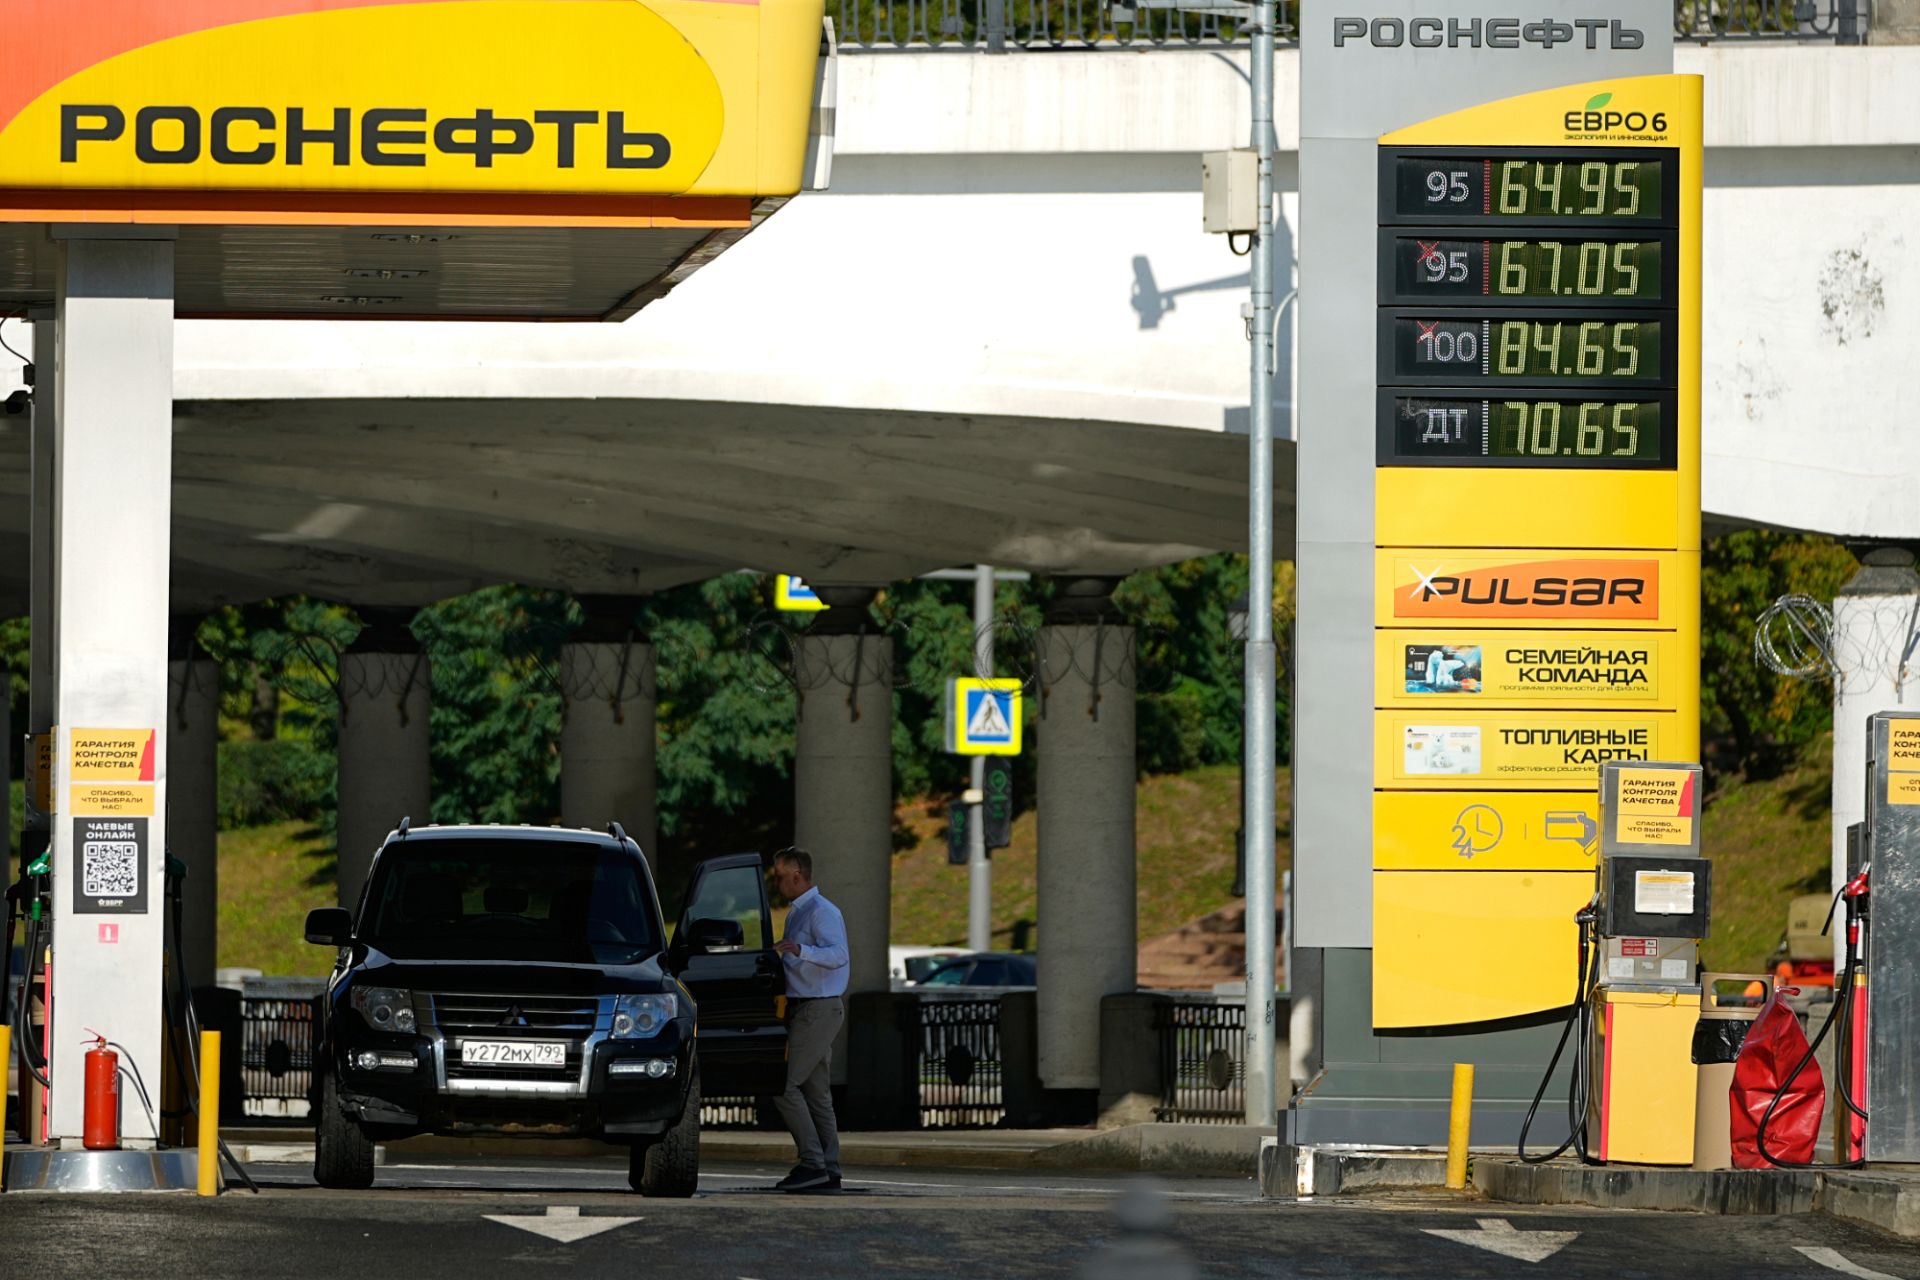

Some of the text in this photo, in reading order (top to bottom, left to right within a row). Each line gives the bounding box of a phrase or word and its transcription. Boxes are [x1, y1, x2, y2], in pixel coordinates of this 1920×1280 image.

[1333, 16, 1645, 50] РОСНЕФТЬ
[60, 104, 672, 169] РОСНЕФТЬ
[1426, 160, 1641, 215] 95 64.95
[1425, 241, 1639, 295] 95 67.05
[1419, 321, 1639, 375] 100 84.65
[1422, 408, 1468, 443] ДТ
[1503, 401, 1639, 455] 70.65
[1505, 647, 1648, 665] СЕМЕЙНАЯ
[1519, 668, 1648, 686] КОМАНДА
[75, 740, 136, 748] ГАРАНТИЯ
[1499, 729, 1648, 745] ТОПЛИВНЫЕ
[75, 751, 138, 759] КОНТРОЛЯ
[1564, 749, 1648, 764] КАРТЫ
[75, 760, 135, 769] КАЧЕСТВА
[1623, 779, 1676, 787] ГАРАНТИЯ
[1623, 788, 1678, 796] КОНТРОЛЯ
[1622, 797, 1675, 805] КАЧЕСТВА
[88, 822, 134, 831] ЧАЕВЫЕ
[86, 831, 136, 839] ОНЛАЙН
[469, 1044, 561, 1061] У272МХ 799
